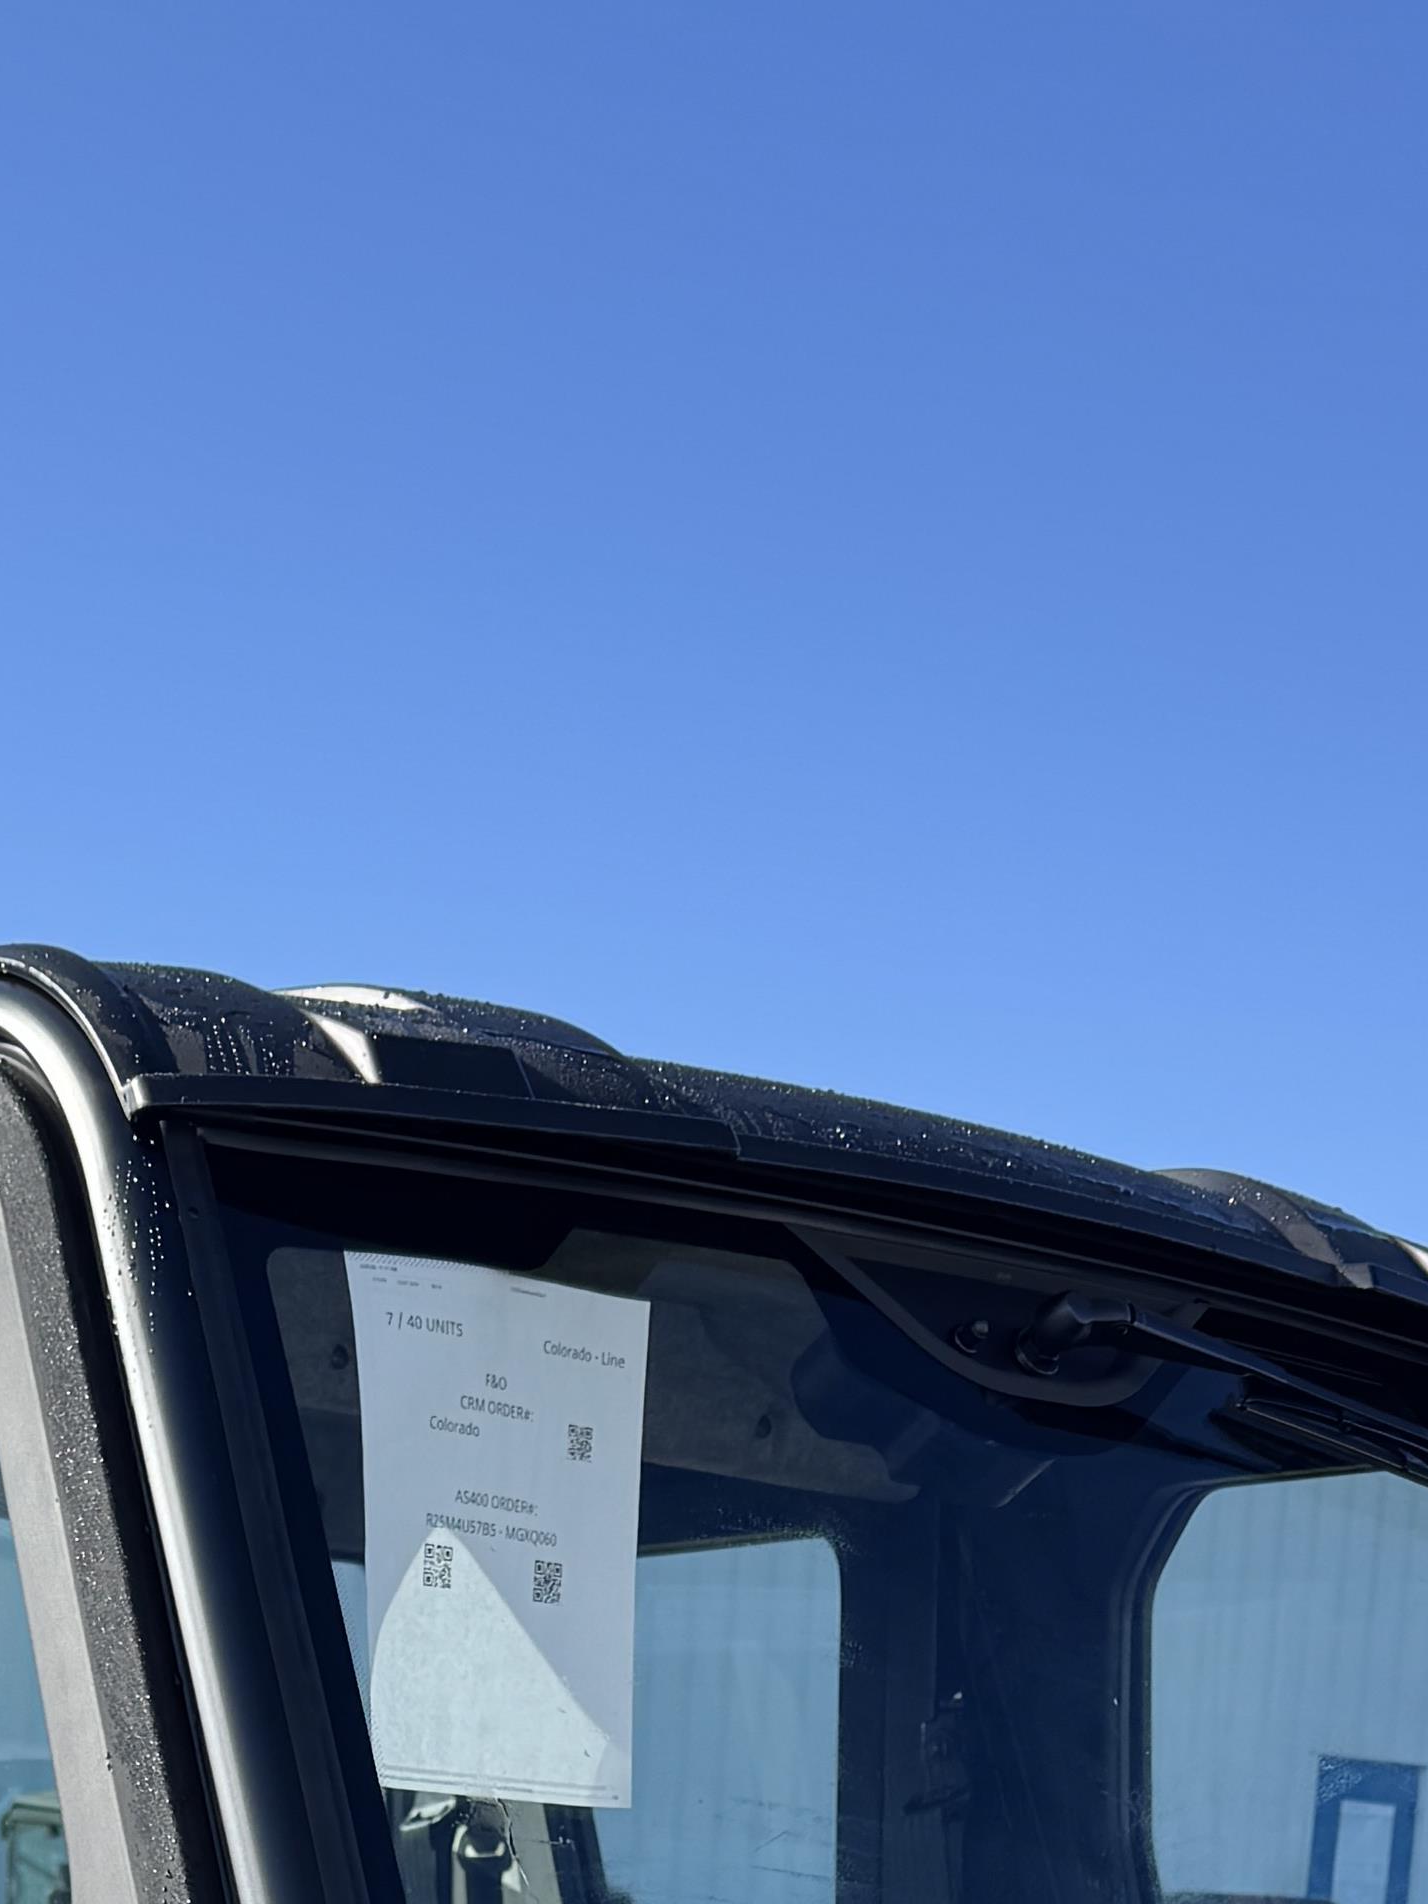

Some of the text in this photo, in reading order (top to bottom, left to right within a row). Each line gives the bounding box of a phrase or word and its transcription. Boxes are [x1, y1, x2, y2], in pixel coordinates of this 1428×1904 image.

[407, 1315, 422, 1331] 40
[426, 1318, 464, 1338] UNITS
[543, 1340, 592, 1363] Colorado
[601, 1352, 626, 1369] Line
[485, 1373, 508, 1391] F&O
[460, 1395, 486, 1413] CRM
[429, 1415, 480, 1438] Colorado
